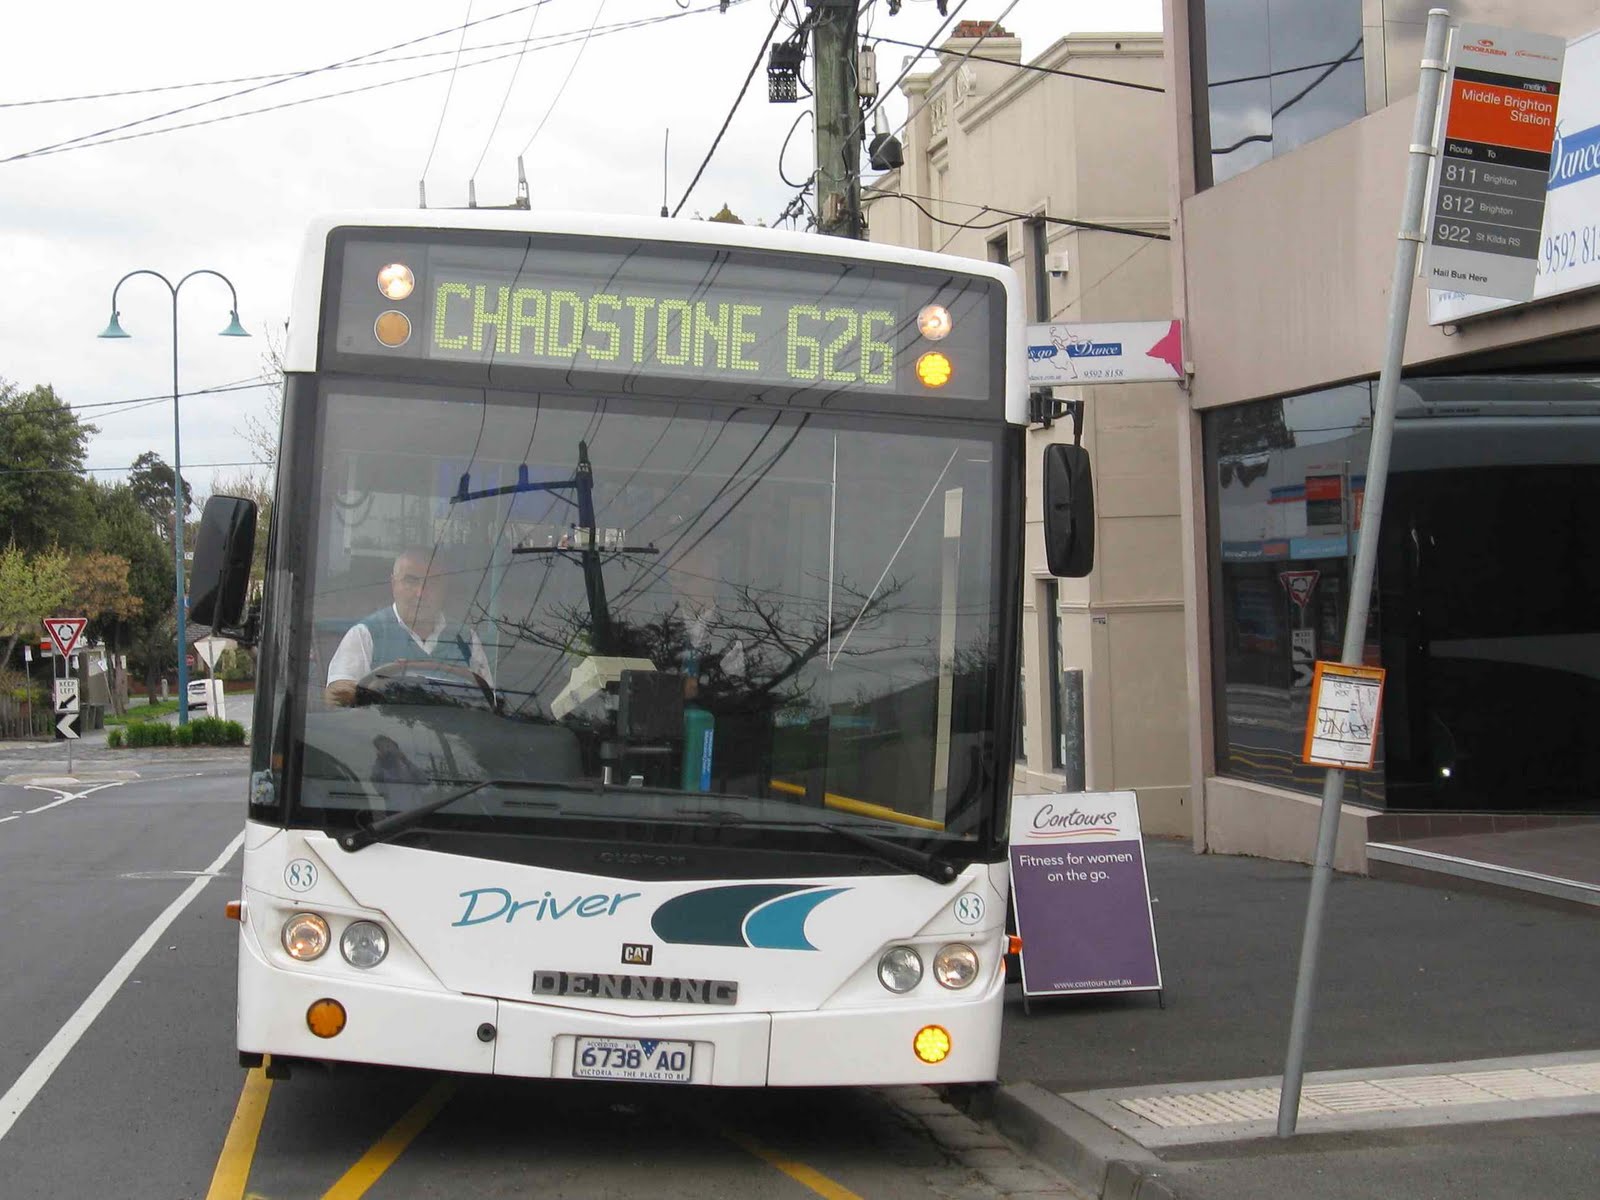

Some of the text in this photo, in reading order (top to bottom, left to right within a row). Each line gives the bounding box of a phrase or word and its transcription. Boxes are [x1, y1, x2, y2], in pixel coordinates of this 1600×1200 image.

[1523, 82, 1547, 92] metlink
[1461, 88, 1553, 113] Middle Brighton
[1510, 110, 1551, 127] Station
[1449, 143, 1497, 159] Route To
[1446, 165, 1518, 186] 811 Brighton
[1442, 194, 1514, 215] 812 Brighton
[1438, 224, 1521, 246] 922 St Kilda RS
[1546, 224, 1600, 274] 9592 81
[1433, 267, 1488, 283] Hail Bus Here
[433, 282, 896, 384] CHADSTONE 626
[1074, 340, 1119, 357] Dance
[1083, 370, 1103, 379] 9592
[1033, 804, 1117, 829] Contours
[1019, 852, 1133, 867] Fitness for women
[289, 863, 313, 887] 83
[1047, 868, 1110, 883] on the go.
[451, 887, 642, 928] Driver
[958, 896, 981, 920] 83
[624, 946, 650, 962] CAT
[532, 970, 739, 1006] DENNING
[1053, 979, 1132, 990] www.contours.net.au
[582, 1047, 685, 1071] 6738 AO
[579, 1068, 612, 1077] VICTORIA
[623, 1070, 636, 1078] THE
[640, 1071, 661, 1079] PLACE
[664, 1072, 674, 1080] TO
[676, 1073, 684, 1081] BE
